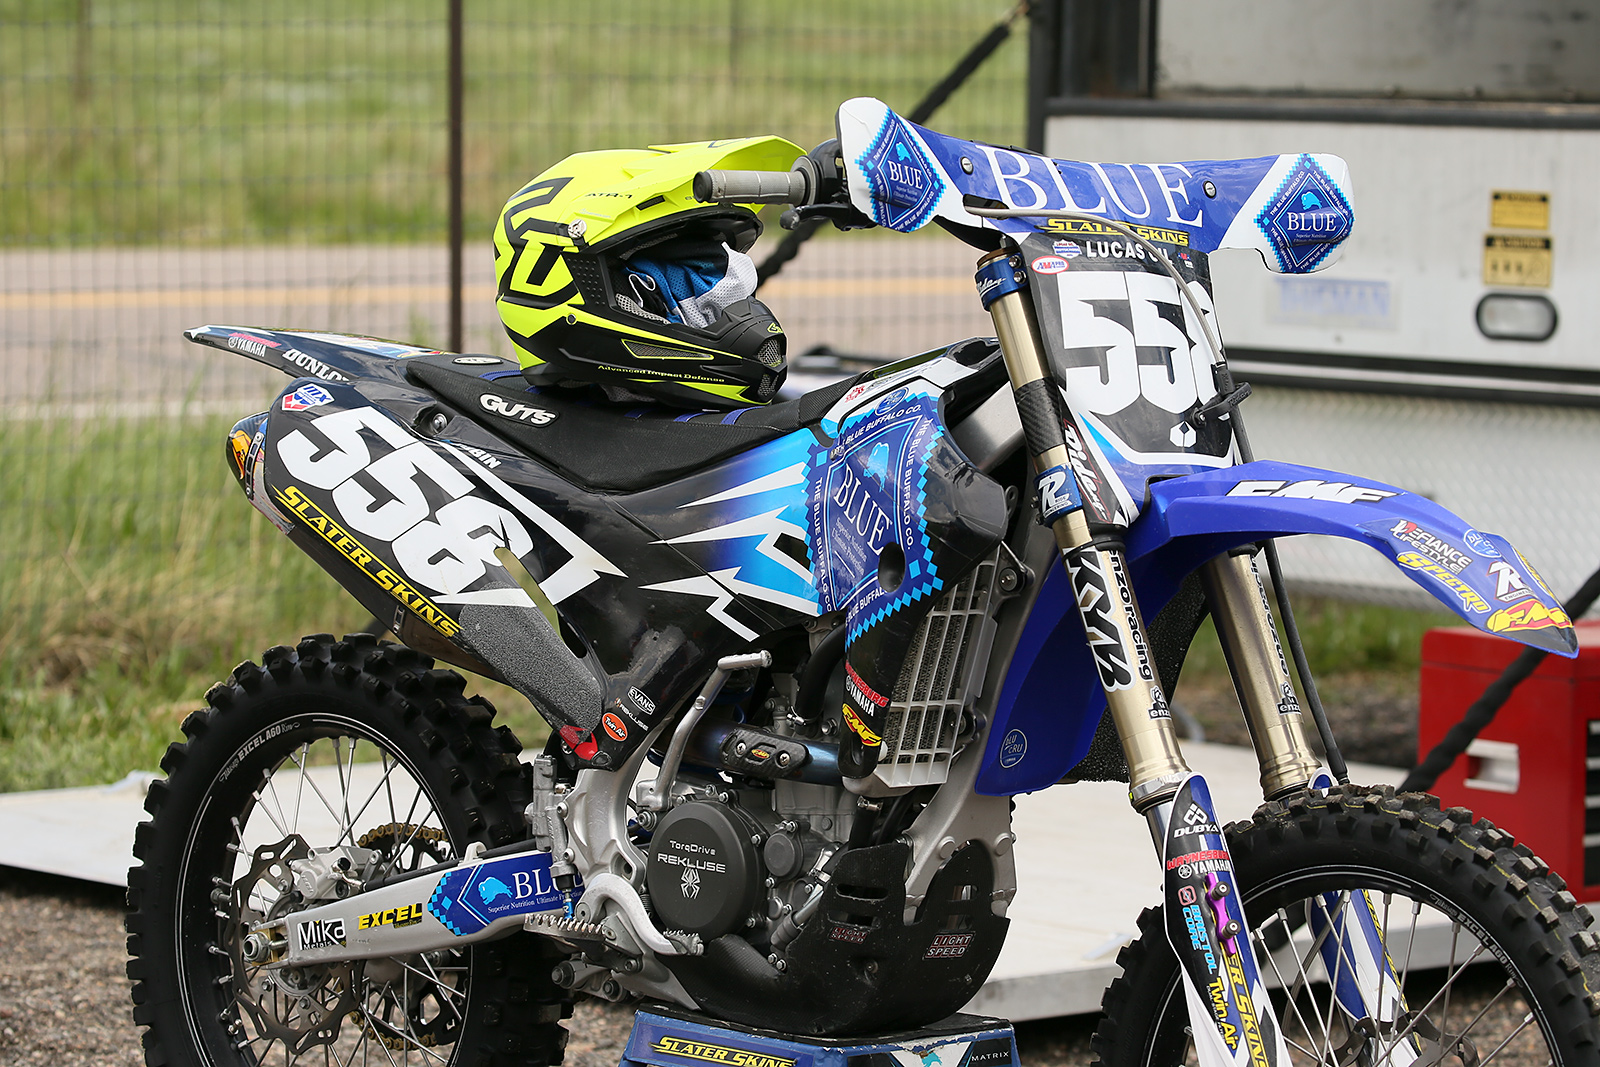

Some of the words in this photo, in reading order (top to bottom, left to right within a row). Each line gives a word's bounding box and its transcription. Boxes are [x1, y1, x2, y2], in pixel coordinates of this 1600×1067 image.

[887, 160, 923, 190] BLUE
[974, 144, 1206, 229] BLUE
[1136, 227, 1189, 246] SKINS
[1286, 211, 1337, 232] BLUE
[1086, 240, 1146, 260] LUCAS
[237, 337, 266, 357] YAMAHA
[282, 348, 350, 381] DUNLO
[598, 365, 646, 375] Advanced
[646, 369, 683, 378] Impact
[683, 373, 725, 383] Defense
[480, 393, 556, 425] GUTS
[844, 426, 866, 445] BLUE
[865, 408, 905, 433] BUFFALO
[916, 417, 934, 438] THE
[905, 437, 922, 468] BLUE
[813, 477, 823, 502] THE
[903, 468, 914, 526] BUFFALO
[813, 502, 822, 536] BLUE
[833, 462, 893, 556] BLUE
[905, 526, 914, 550] CO.
[1390, 519, 1473, 569] DEFIANCE
[276, 484, 372, 569] SLATER
[375, 568, 461, 638] SKINS
[816, 536, 829, 593] BUFFALO
[1397, 552, 1490, 613] SPECTRO
[859, 586, 888, 610] BUFFAL
[1063, 547, 1136, 692] KYB
[1108, 550, 1132, 605] enzo
[1125, 603, 1154, 682] racing
[629, 688, 654, 713] EVANS
[849, 681, 875, 717] YAMAHA
[604, 716, 617, 731] Twin
[615, 727, 626, 738] Air
[842, 704, 882, 744] FMF
[237, 735, 266, 761] EXCEL
[265, 725, 281, 740] A60
[1173, 823, 1219, 838] DUBYA
[669, 840, 716, 856] TorqDrive
[657, 853, 726, 874] REKLUSE
[1191, 859, 1231, 875] YAMAHA
[358, 903, 423, 931] EXCEL
[487, 903, 510, 914] Superior
[510, 900, 536, 910] Nutrition
[536, 894, 558, 905] Ultimate
[297, 918, 346, 950] Mika
[834, 927, 867, 937] LIGHT
[933, 935, 971, 946] LIGHT
[1182, 906, 1202, 951] CORE
[1190, 904, 1217, 975] BRISTOL
[1457, 912, 1490, 945] EXCEL
[927, 946, 966, 956] SPEED
[1208, 976, 1229, 1019] Twin
[1220, 1020, 1238, 1051] Air
[659, 1037, 729, 1060] SLATER
[971, 1050, 1010, 1062] MATRIX
